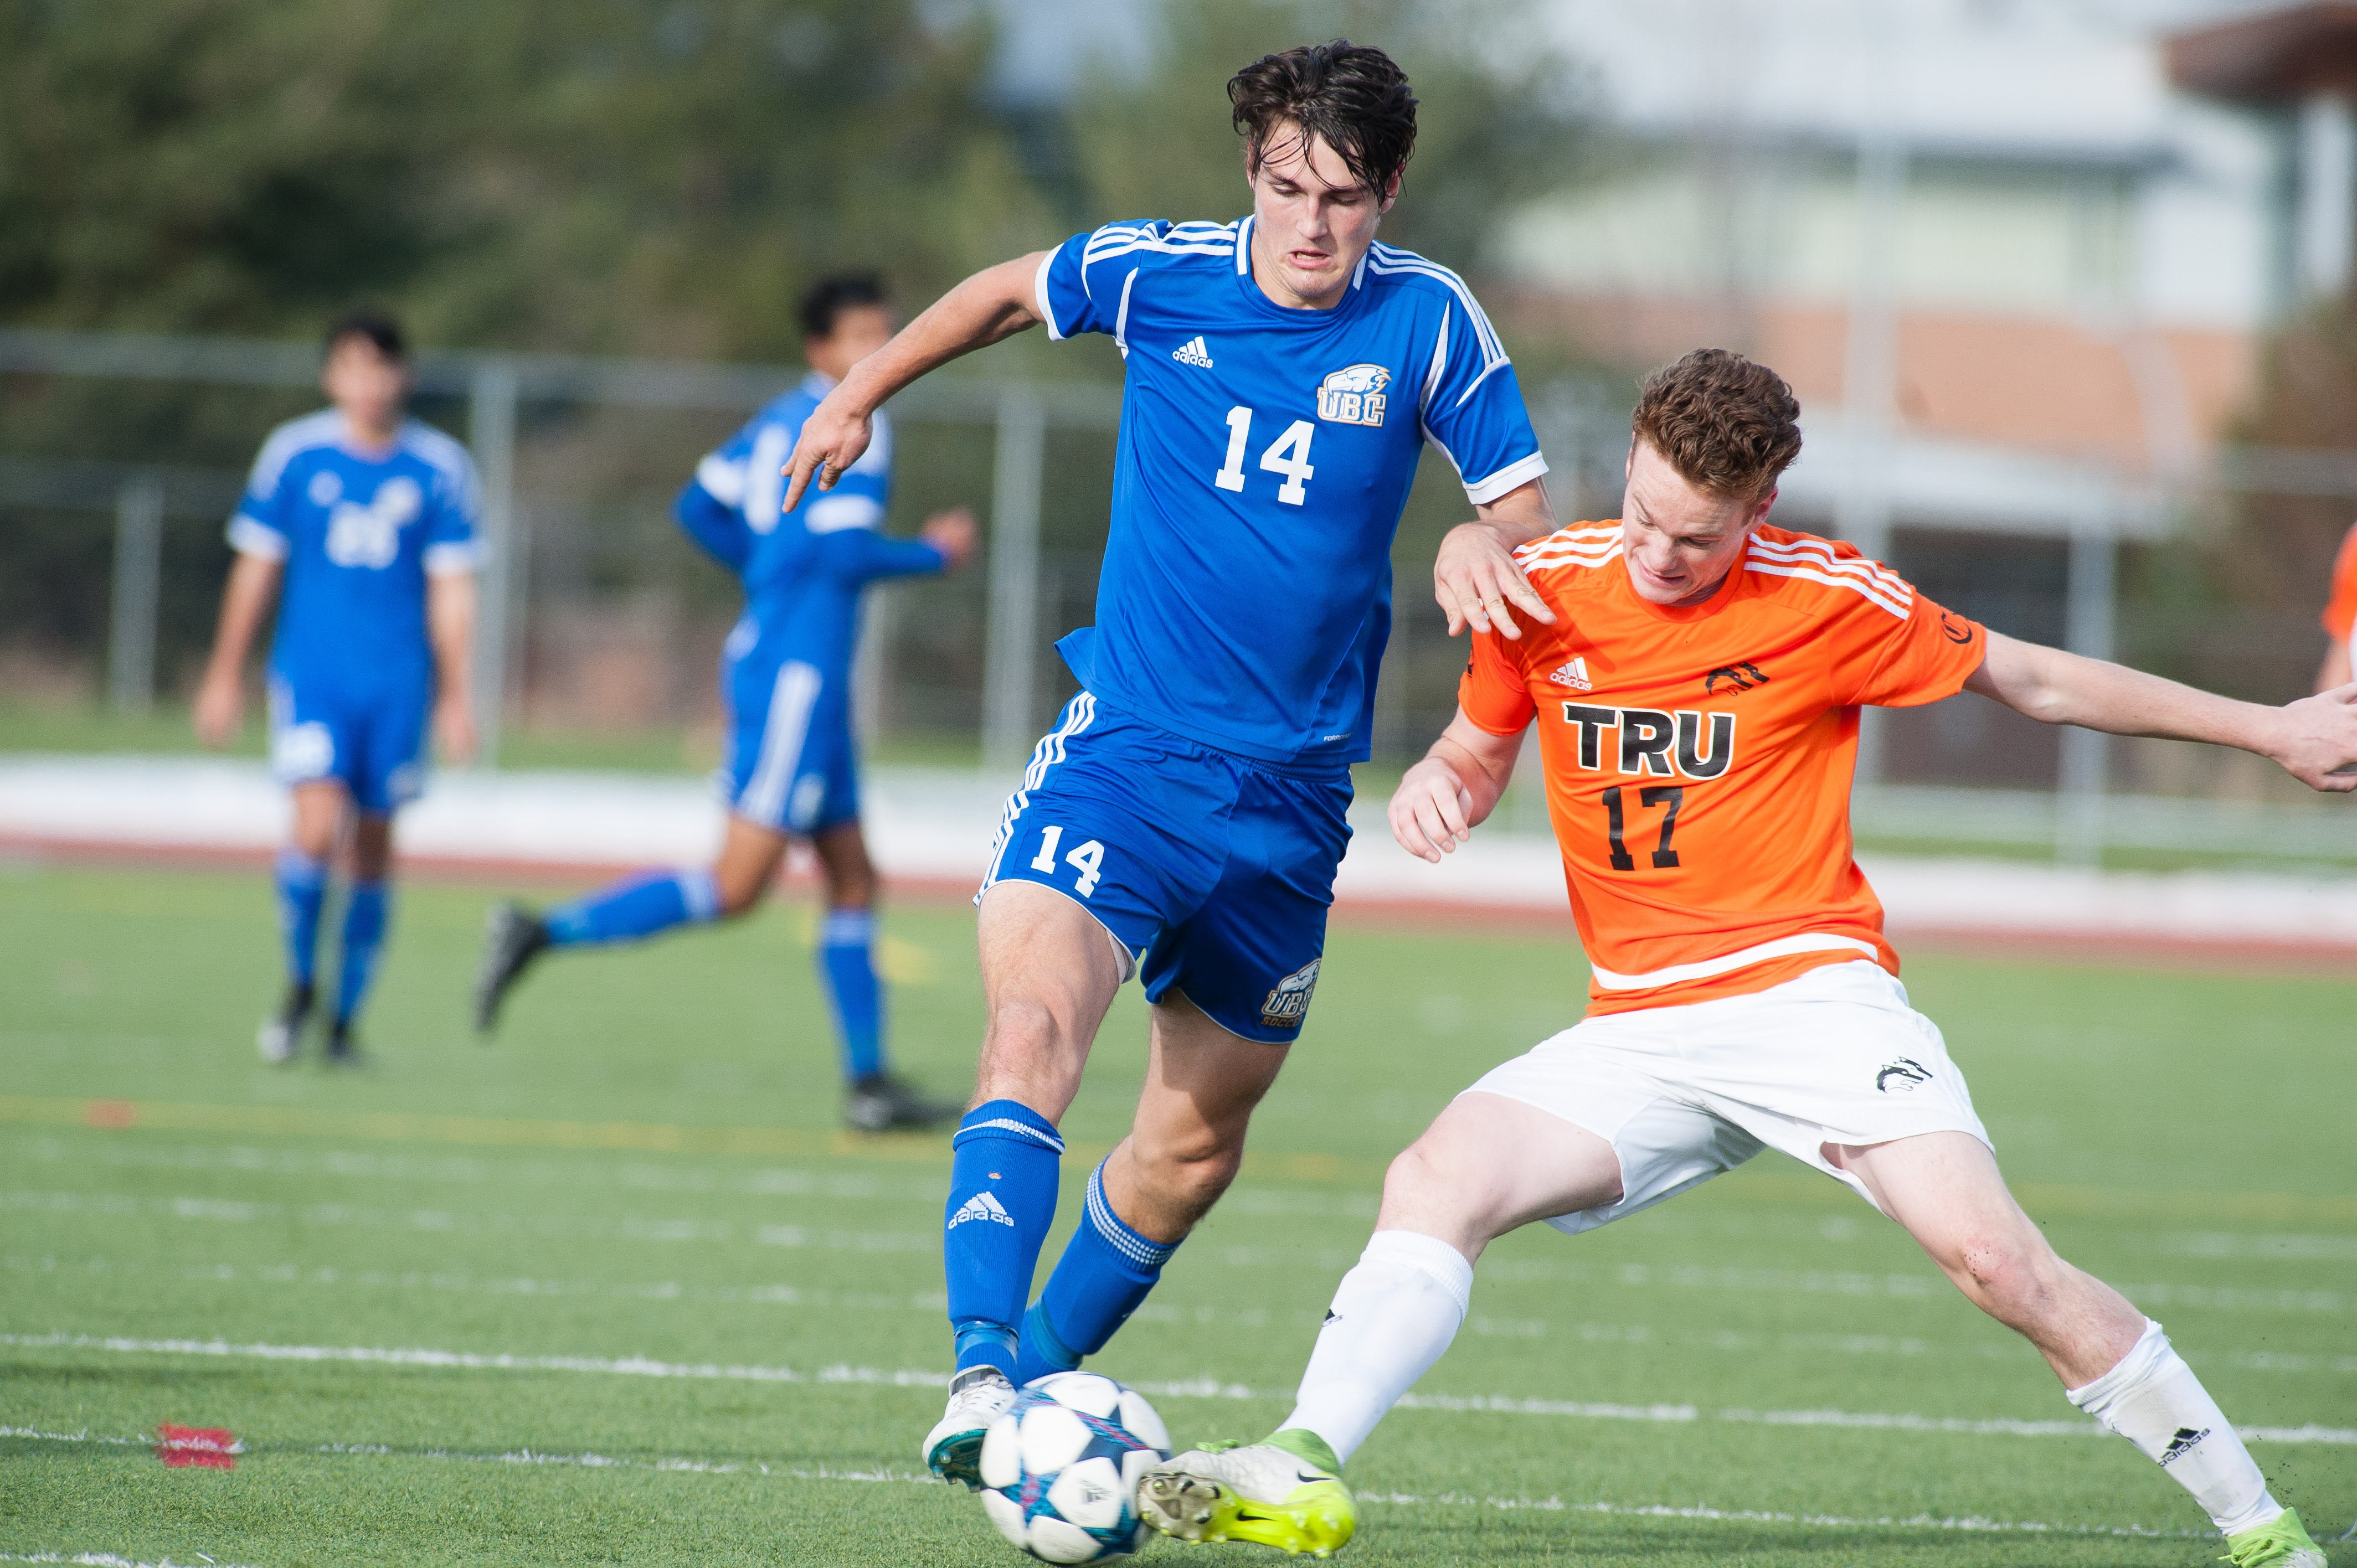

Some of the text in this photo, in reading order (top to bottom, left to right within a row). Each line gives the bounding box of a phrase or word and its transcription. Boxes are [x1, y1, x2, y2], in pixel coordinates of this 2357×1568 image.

[1172, 350, 1213, 368] adidas
[1317, 386, 1386, 427] UBC
[1214, 405, 1315, 506] 14
[1550, 672, 1592, 690] adidas
[1561, 701, 1736, 780] TRU
[1602, 785, 1684, 871] 17
[1031, 825, 1105, 899] 14
[948, 1209, 1015, 1230] adidas
[2158, 1427, 2211, 1467] adidas
